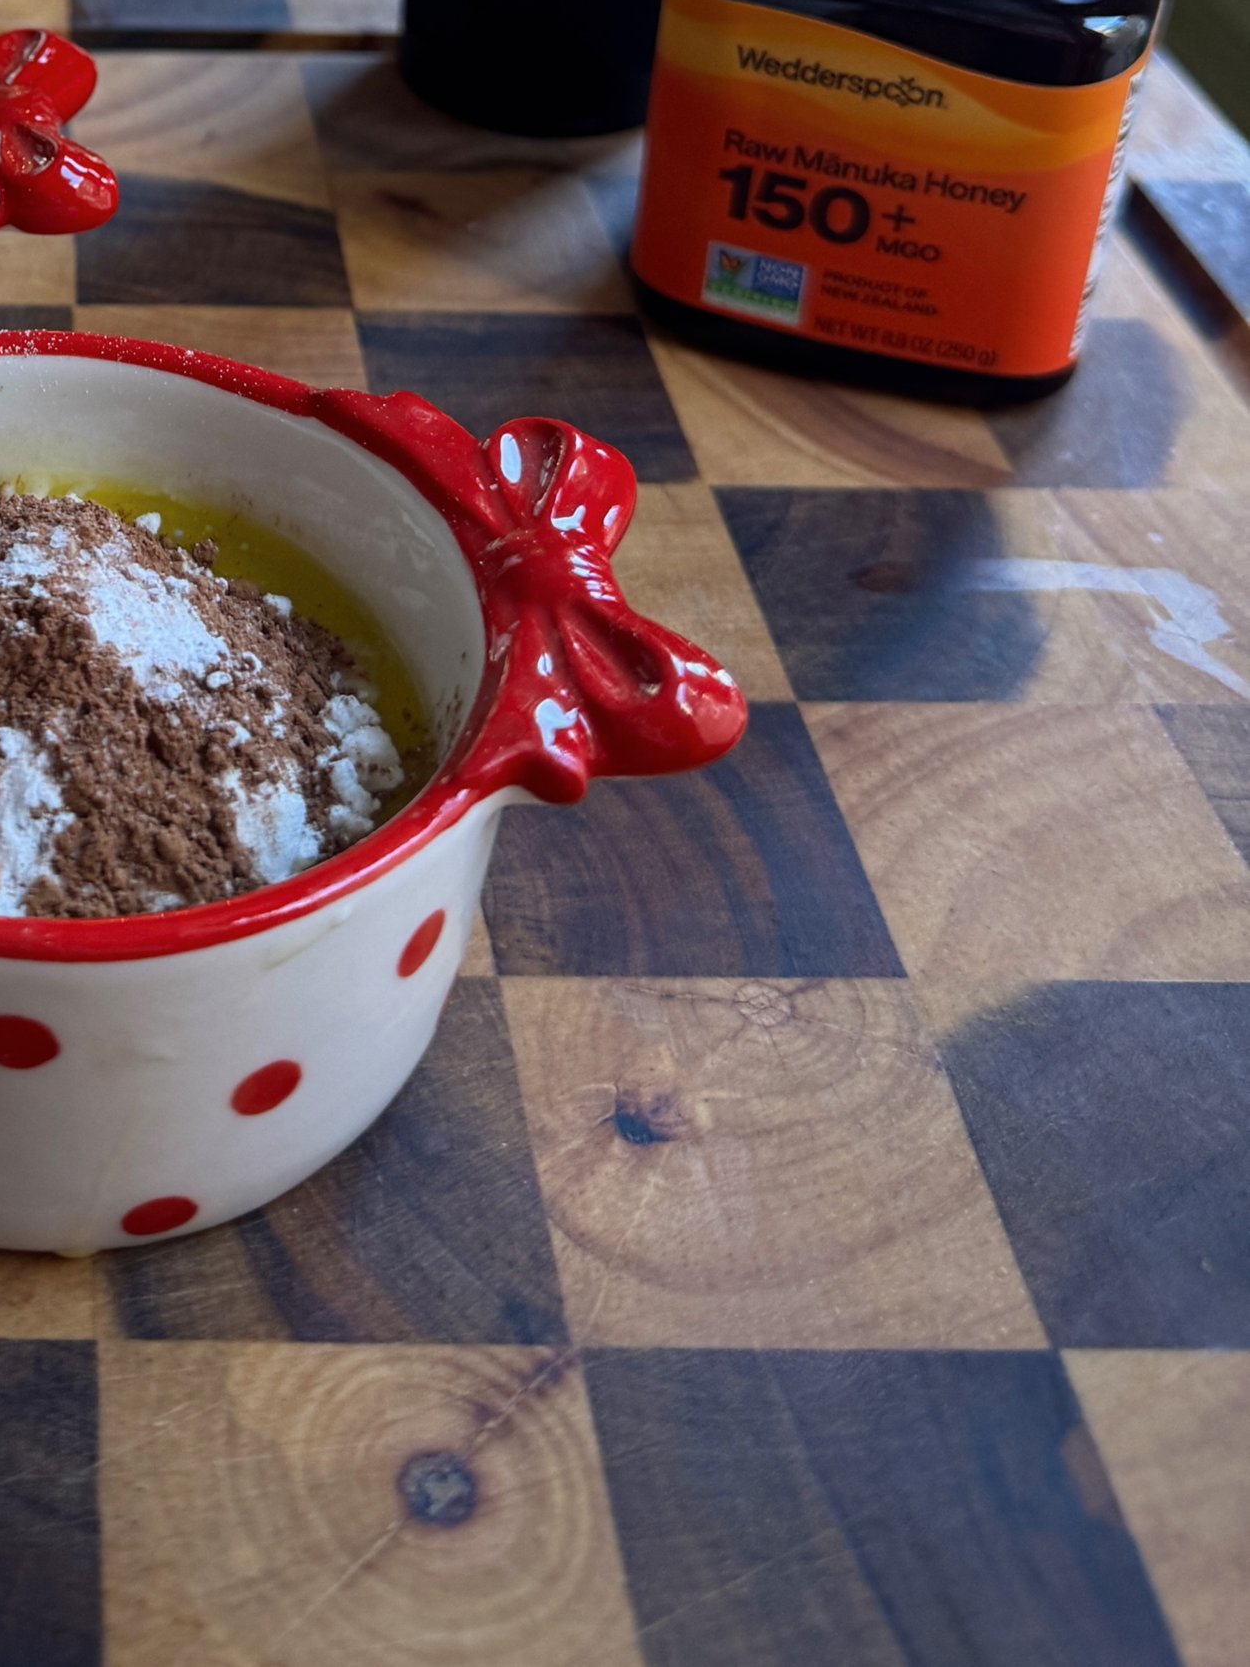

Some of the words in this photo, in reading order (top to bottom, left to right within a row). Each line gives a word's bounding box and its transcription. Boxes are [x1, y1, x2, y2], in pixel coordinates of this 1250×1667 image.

[735, 44, 945, 107] Wedderspoon
[724, 129, 788, 164] Raw
[924, 171, 1027, 214] Honey
[875, 235, 942, 263] MGO
[814, 316, 847, 335] NET
[851, 323, 879, 343] WT
[910, 335, 934, 355] OZ
